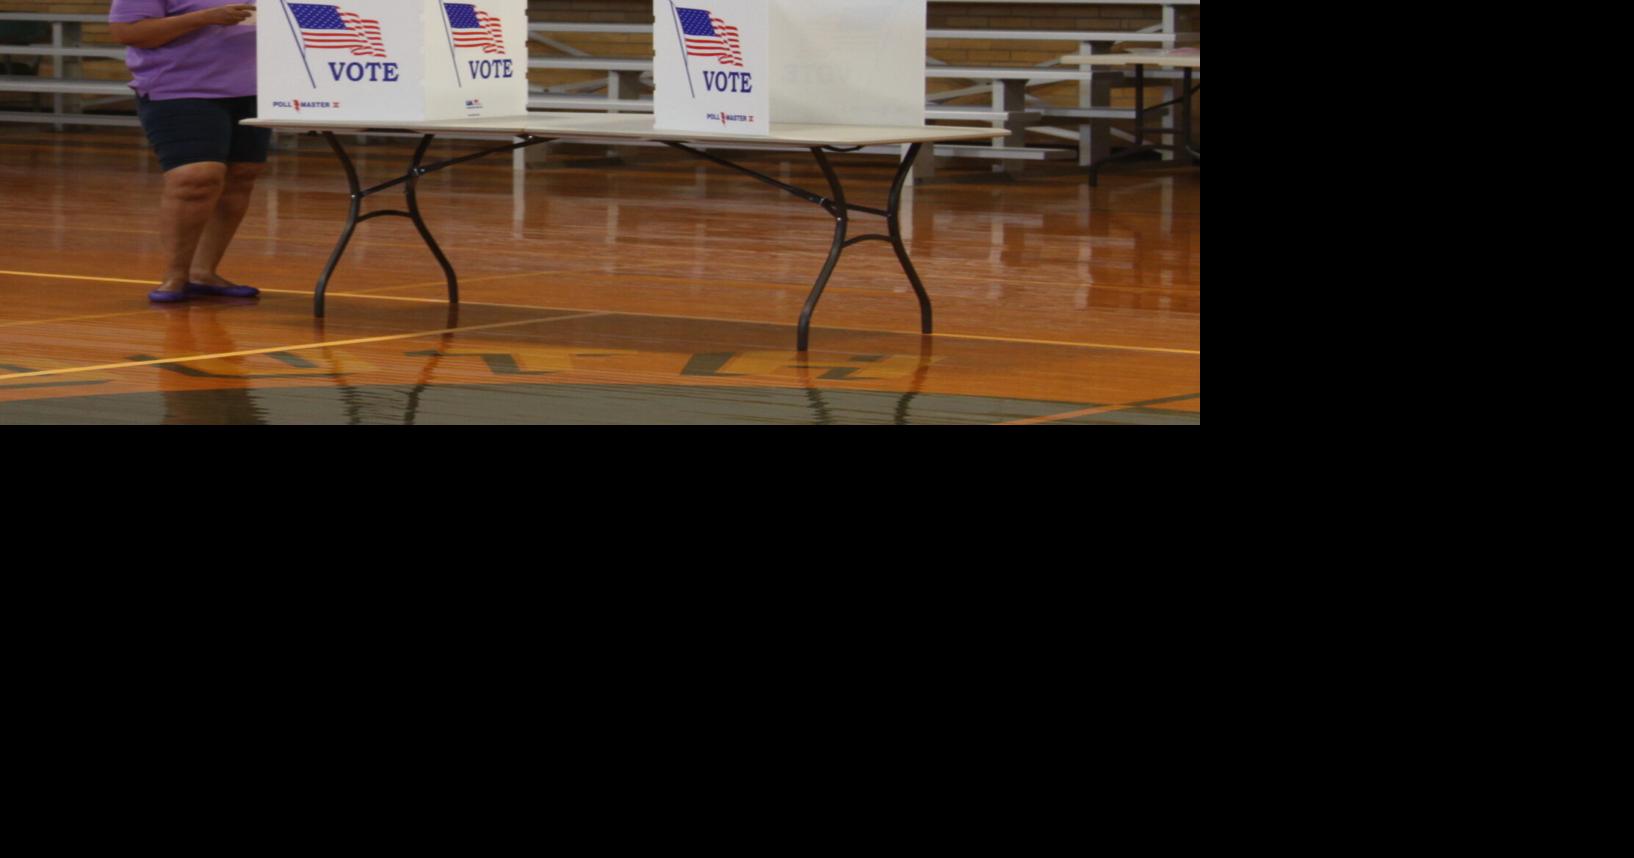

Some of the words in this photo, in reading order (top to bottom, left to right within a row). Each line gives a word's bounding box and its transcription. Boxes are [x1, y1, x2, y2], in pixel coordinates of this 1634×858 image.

[328, 62, 399, 82] VOTE
[469, 59, 513, 79] VOTE
[703, 71, 752, 93] VOTE
[707, 113, 720, 121] POLL
